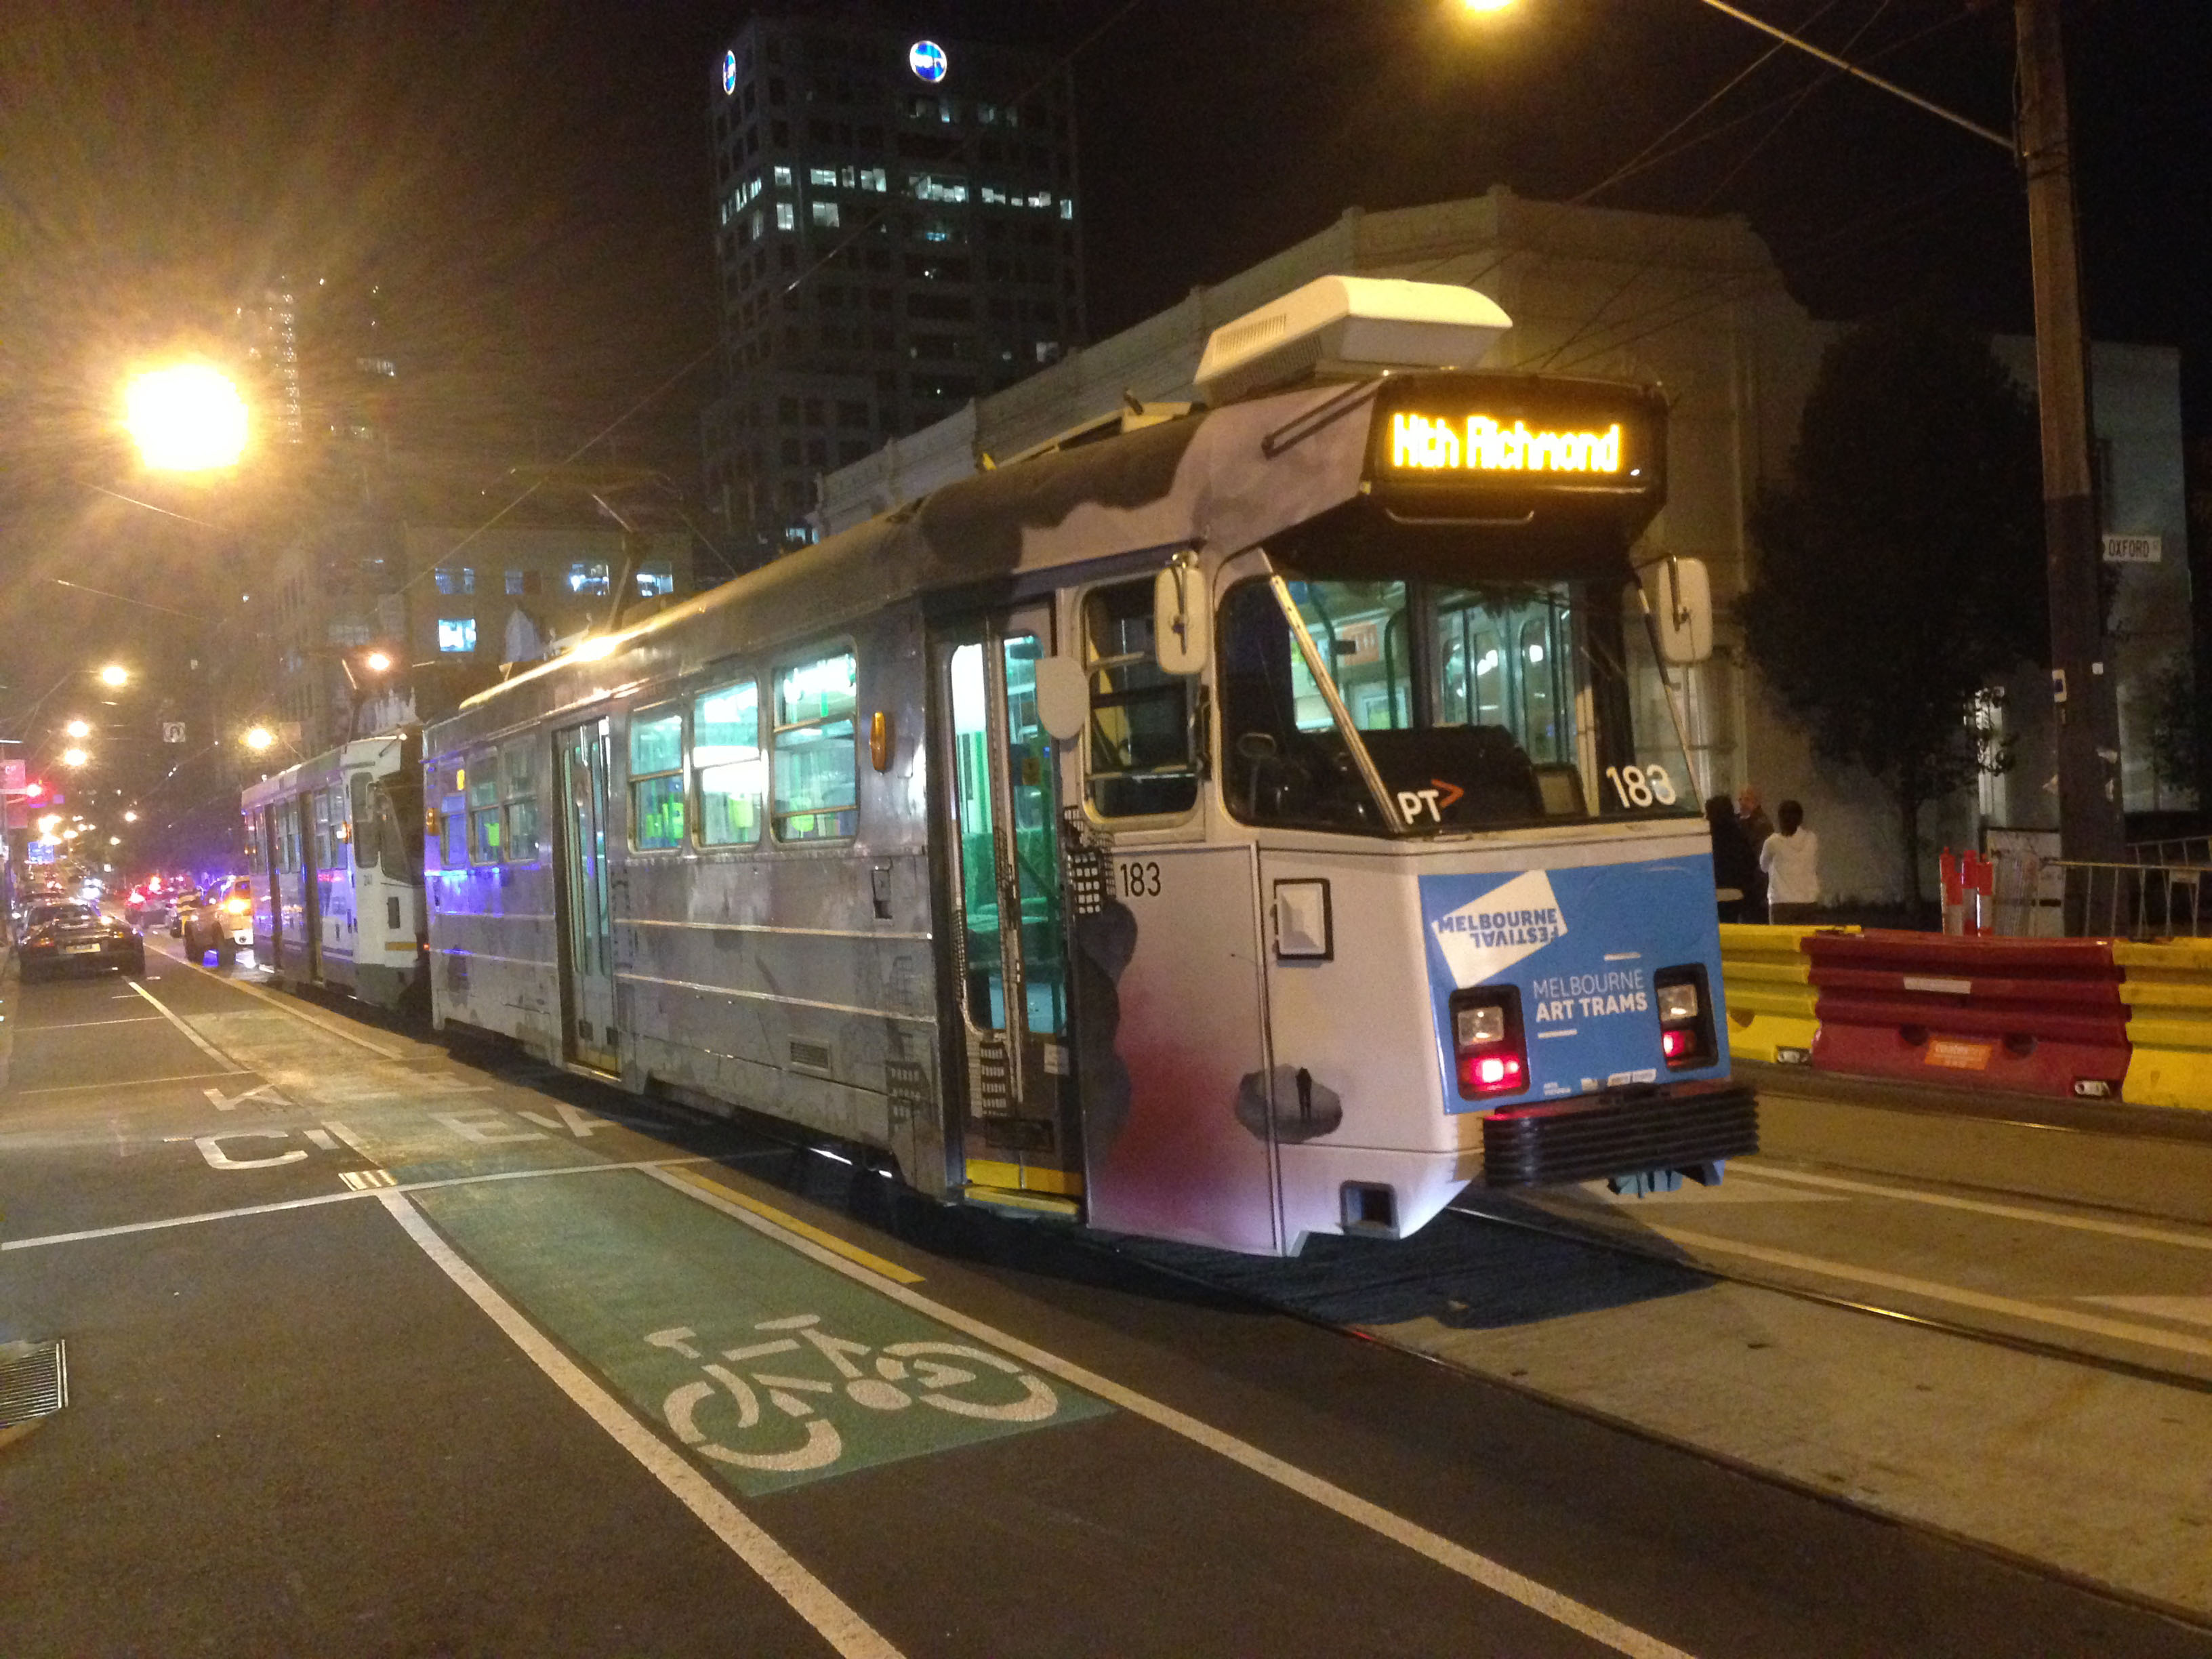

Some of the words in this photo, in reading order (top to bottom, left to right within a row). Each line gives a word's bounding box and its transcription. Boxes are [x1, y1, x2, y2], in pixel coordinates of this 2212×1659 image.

[1393, 413, 1460, 468] Nth
[1465, 414, 1621, 472] Richmond
[2108, 539, 2150, 558] OXFORD
[1605, 764, 1676, 808] 183
[1120, 861, 1161, 897] 183
[1438, 908, 1558, 933] MELBOURNE
[1532, 968, 1645, 1000] MELBOURNE
[1535, 998, 1575, 1023] ART
[1578, 991, 1649, 1017] TRAMS
